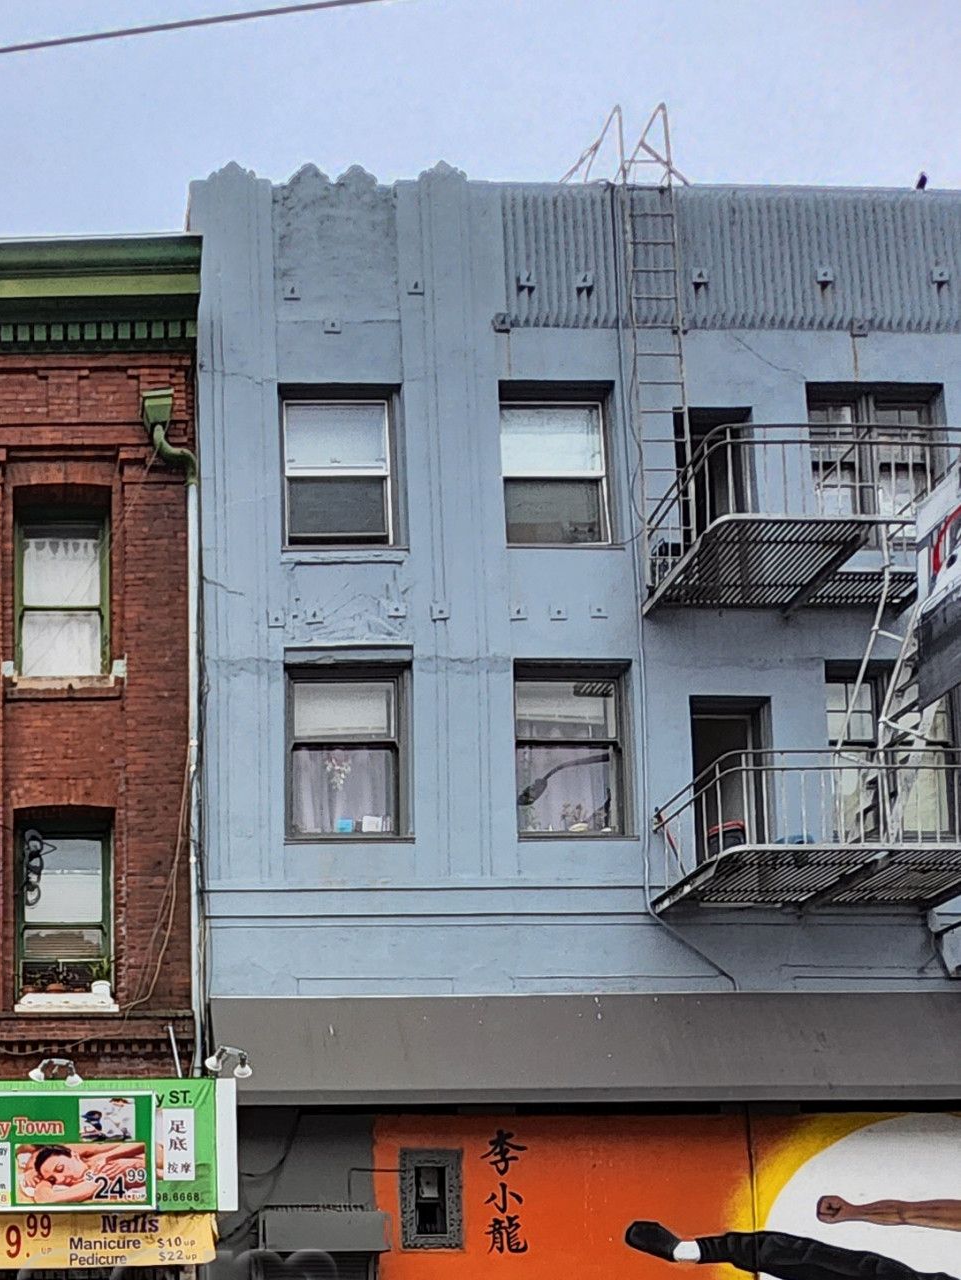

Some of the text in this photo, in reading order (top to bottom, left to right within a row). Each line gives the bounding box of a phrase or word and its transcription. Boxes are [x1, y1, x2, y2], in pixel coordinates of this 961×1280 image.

[169, 1090, 192, 1104] ST.
[14, 1117, 64, 1136] Town
[168, 1119, 188, 1151] 足底
[167, 1162, 192, 1174] 按摩
[480, 1129, 528, 1255] 李小龍
[101, 1215, 160, 1234] Nails
[69, 1236, 142, 1251] Manicure
[157, 1236, 182, 1249] $10
[69, 1252, 128, 1266] Pedicure
[158, 1250, 184, 1262] $22
